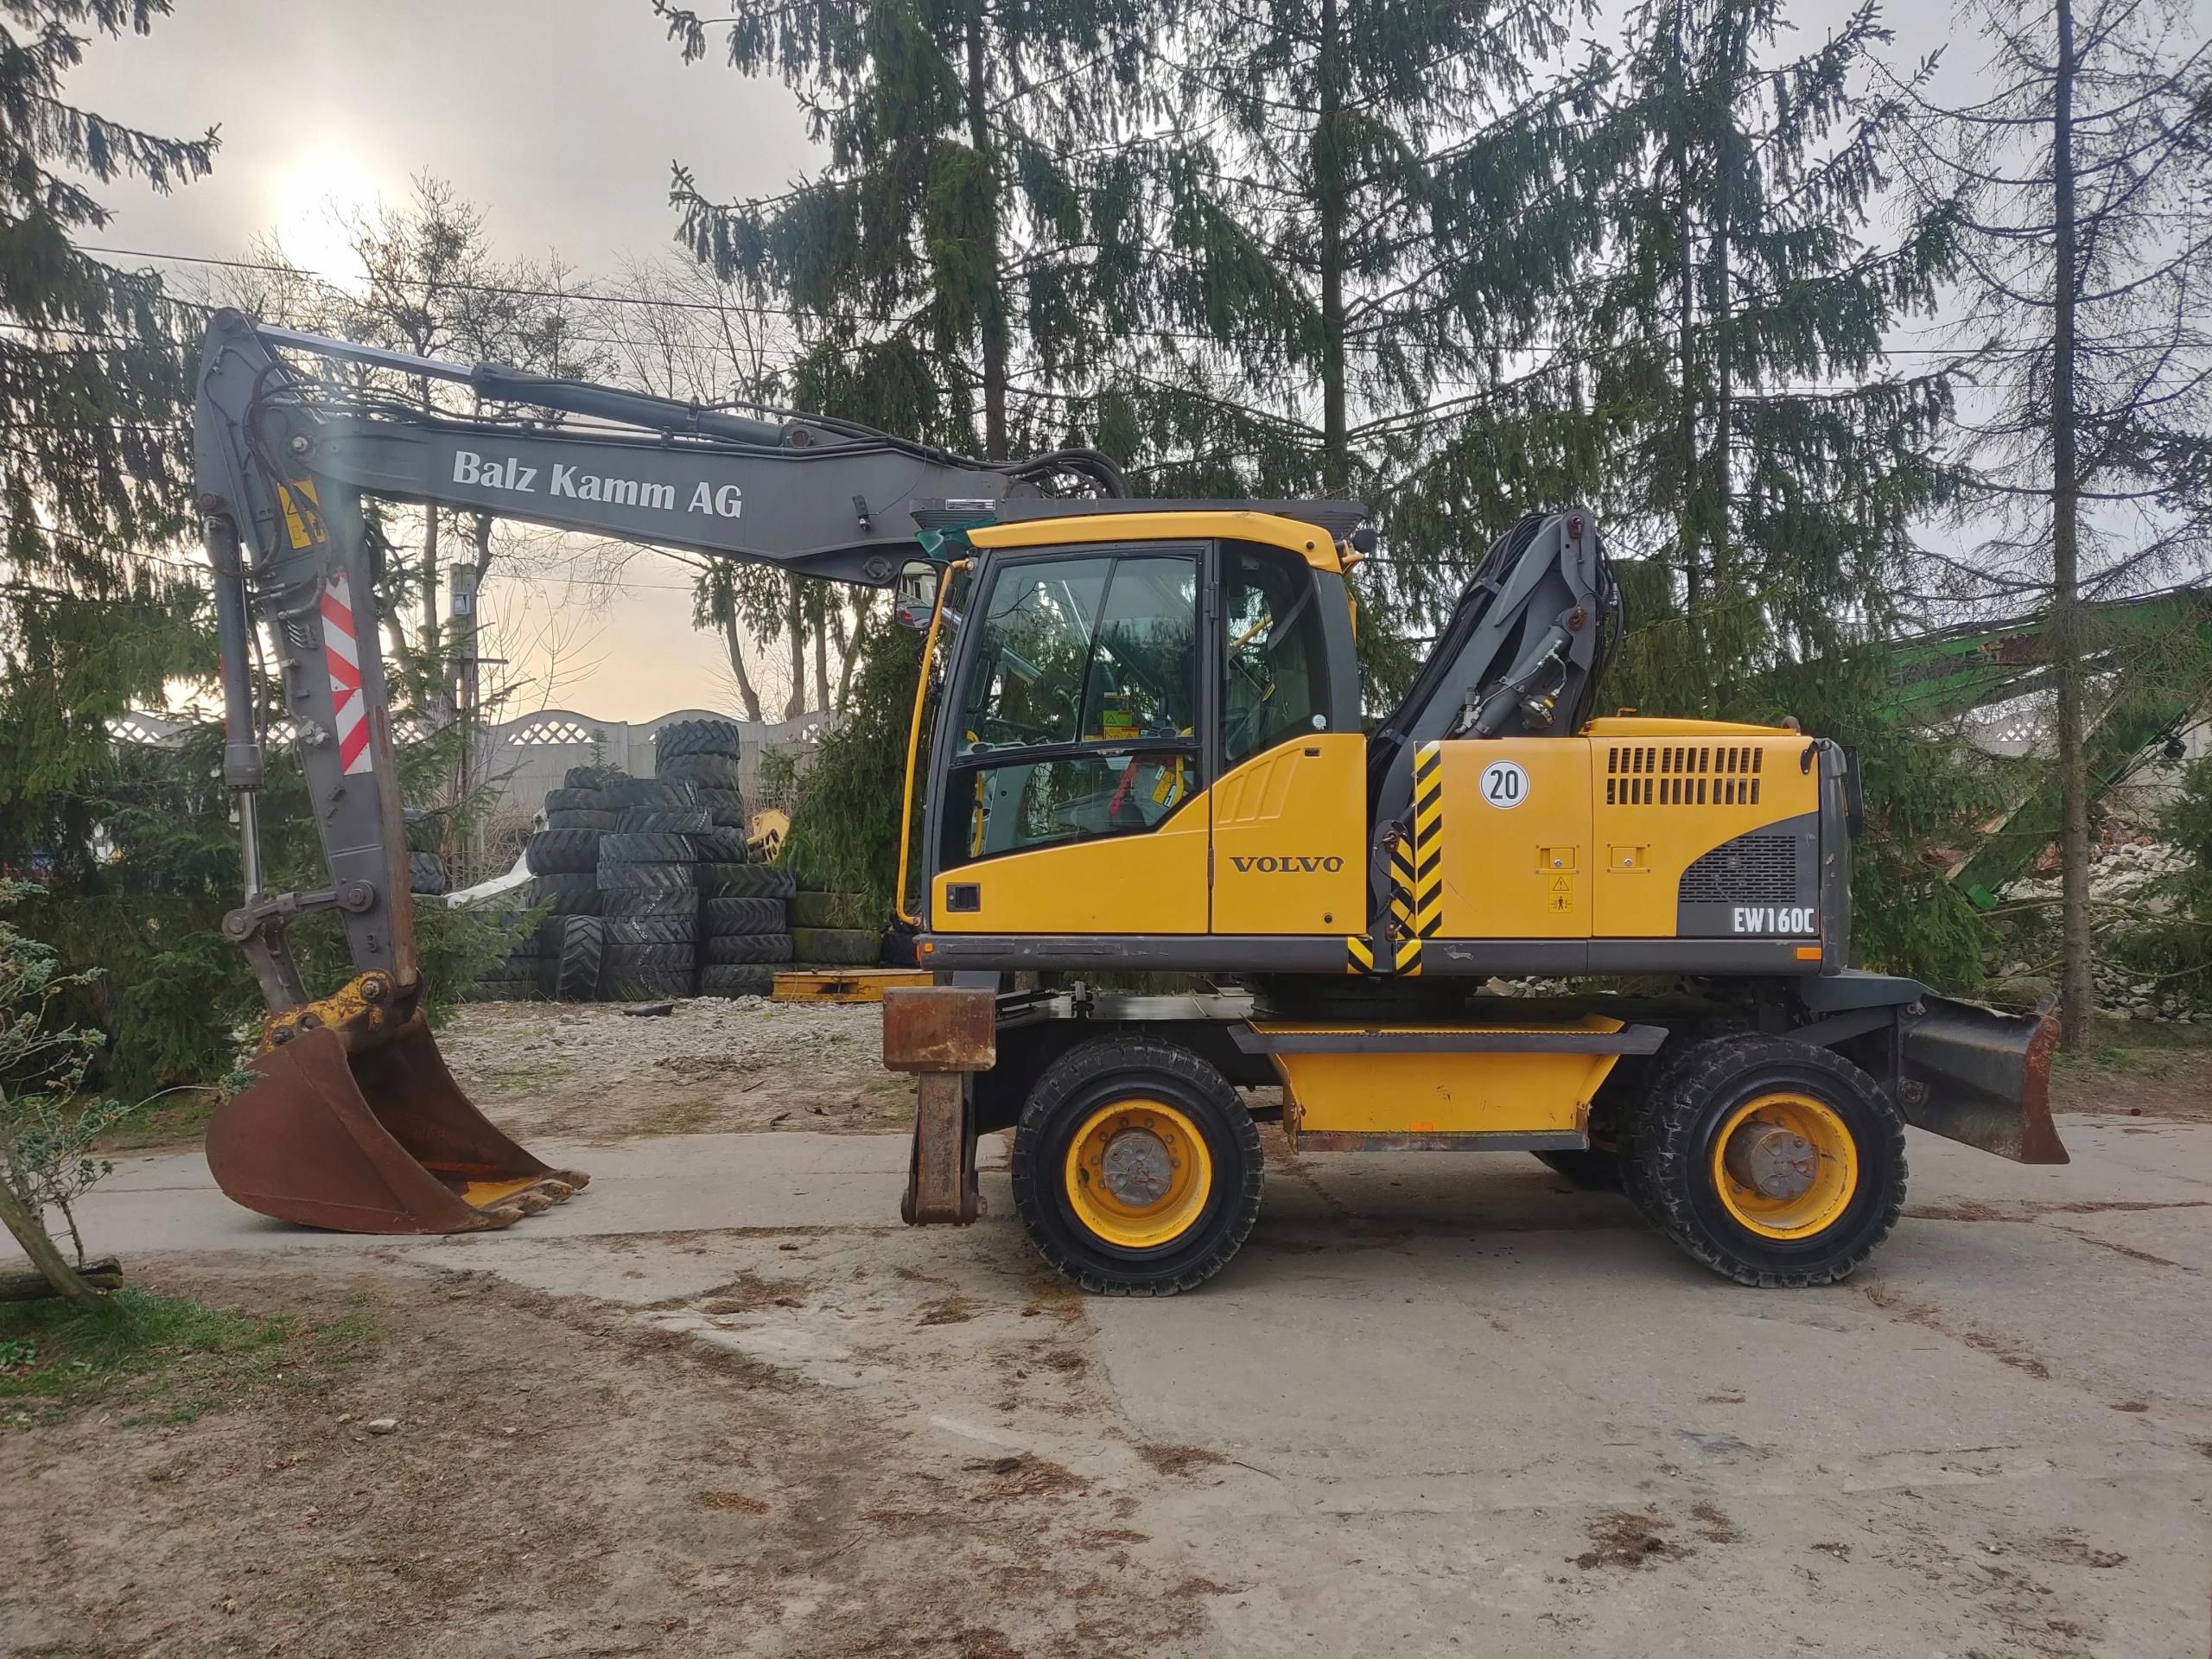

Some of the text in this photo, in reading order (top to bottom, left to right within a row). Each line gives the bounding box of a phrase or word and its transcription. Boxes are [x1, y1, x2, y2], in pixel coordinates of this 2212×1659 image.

[452, 449, 743, 518] Balz Kamm AG
[1490, 769, 1519, 799] 20
[1229, 856, 1344, 873] VOLVO
[1734, 907, 1815, 933] EW160C
